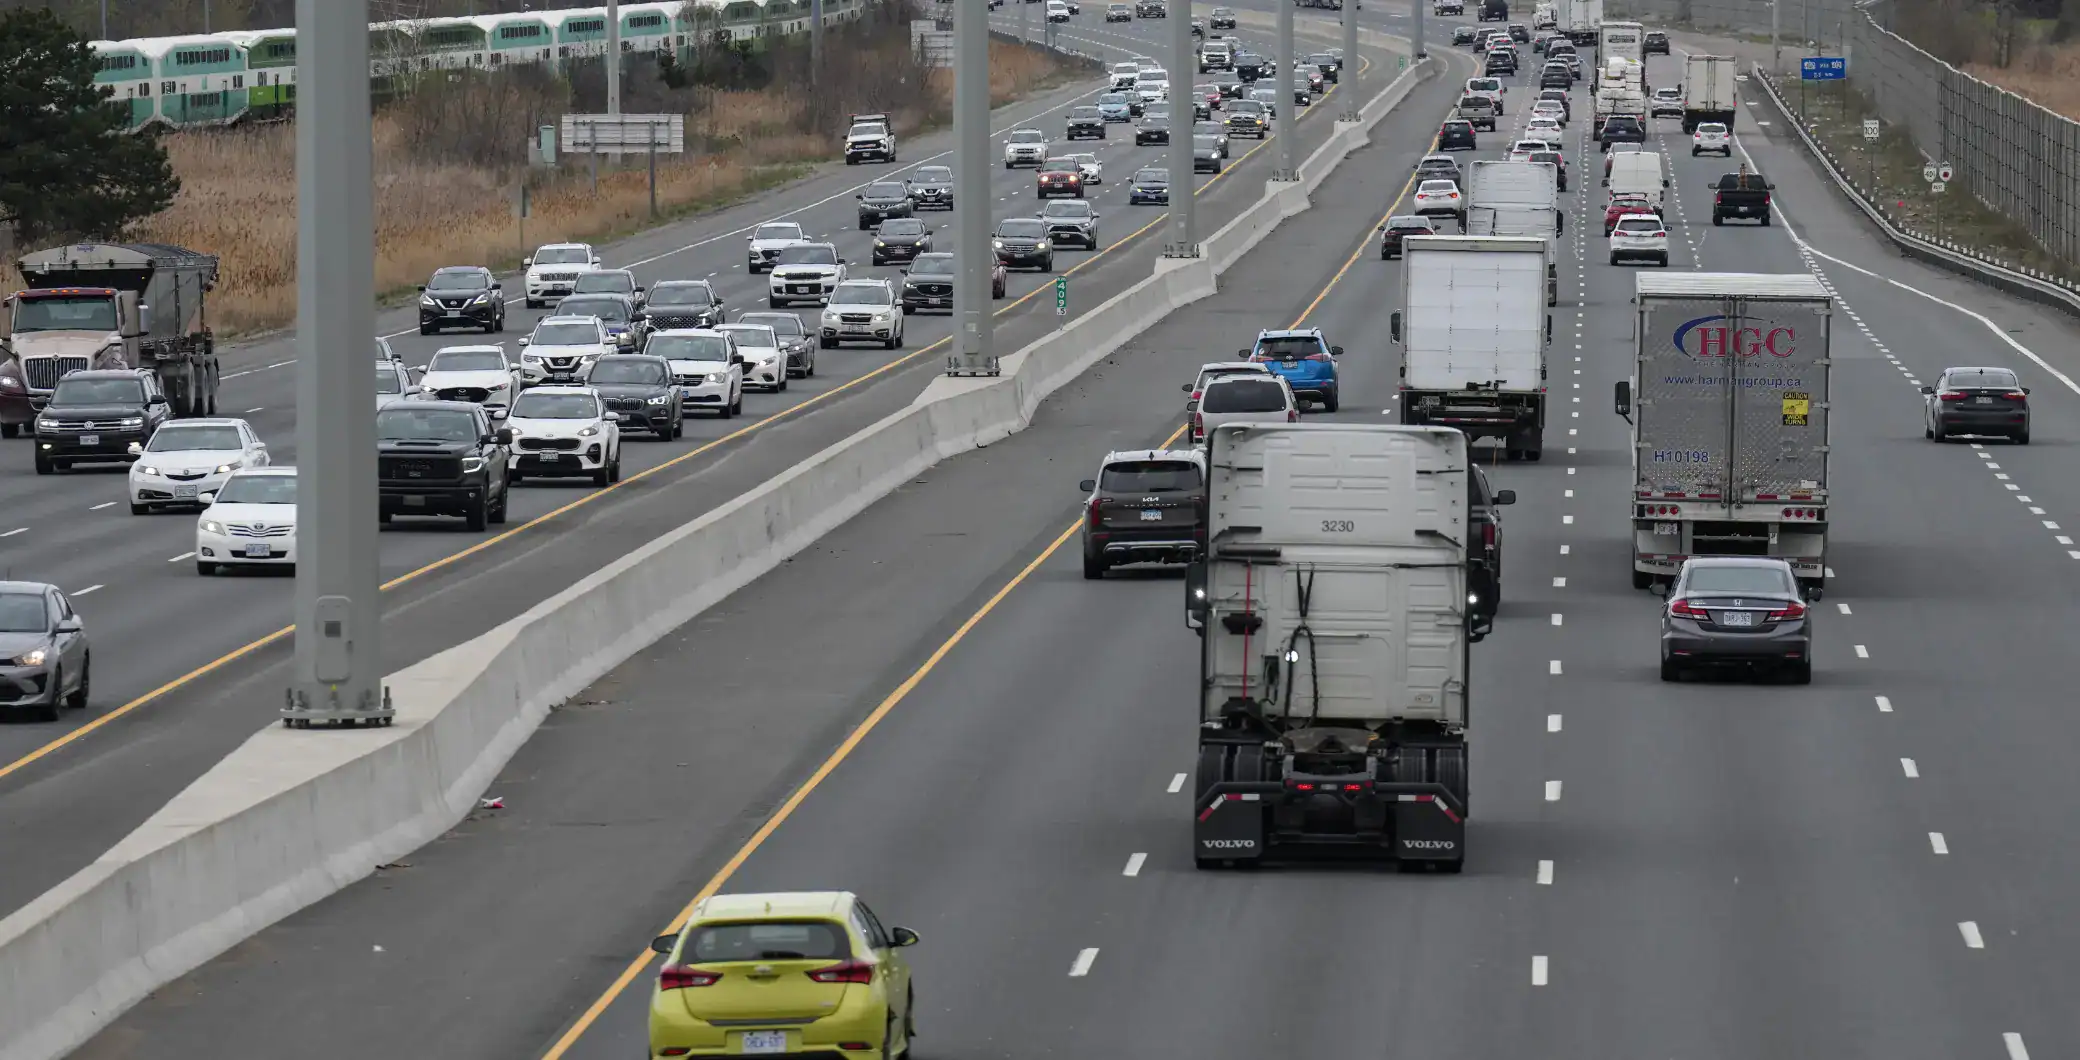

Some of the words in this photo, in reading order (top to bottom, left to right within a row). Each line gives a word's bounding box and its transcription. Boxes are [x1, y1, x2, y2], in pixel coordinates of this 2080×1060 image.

[1864, 126, 1878, 135] 100
[1695, 327, 1796, 358] HGC
[1664, 375, 1801, 388] www.harmangroup.ca
[1784, 392, 1809, 400] CAUTION
[1654, 450, 1709, 462] H10198
[1321, 520, 1355, 532] 3230
[1202, 840, 1255, 849] VOLVO
[1402, 840, 1455, 849] VOLVO
